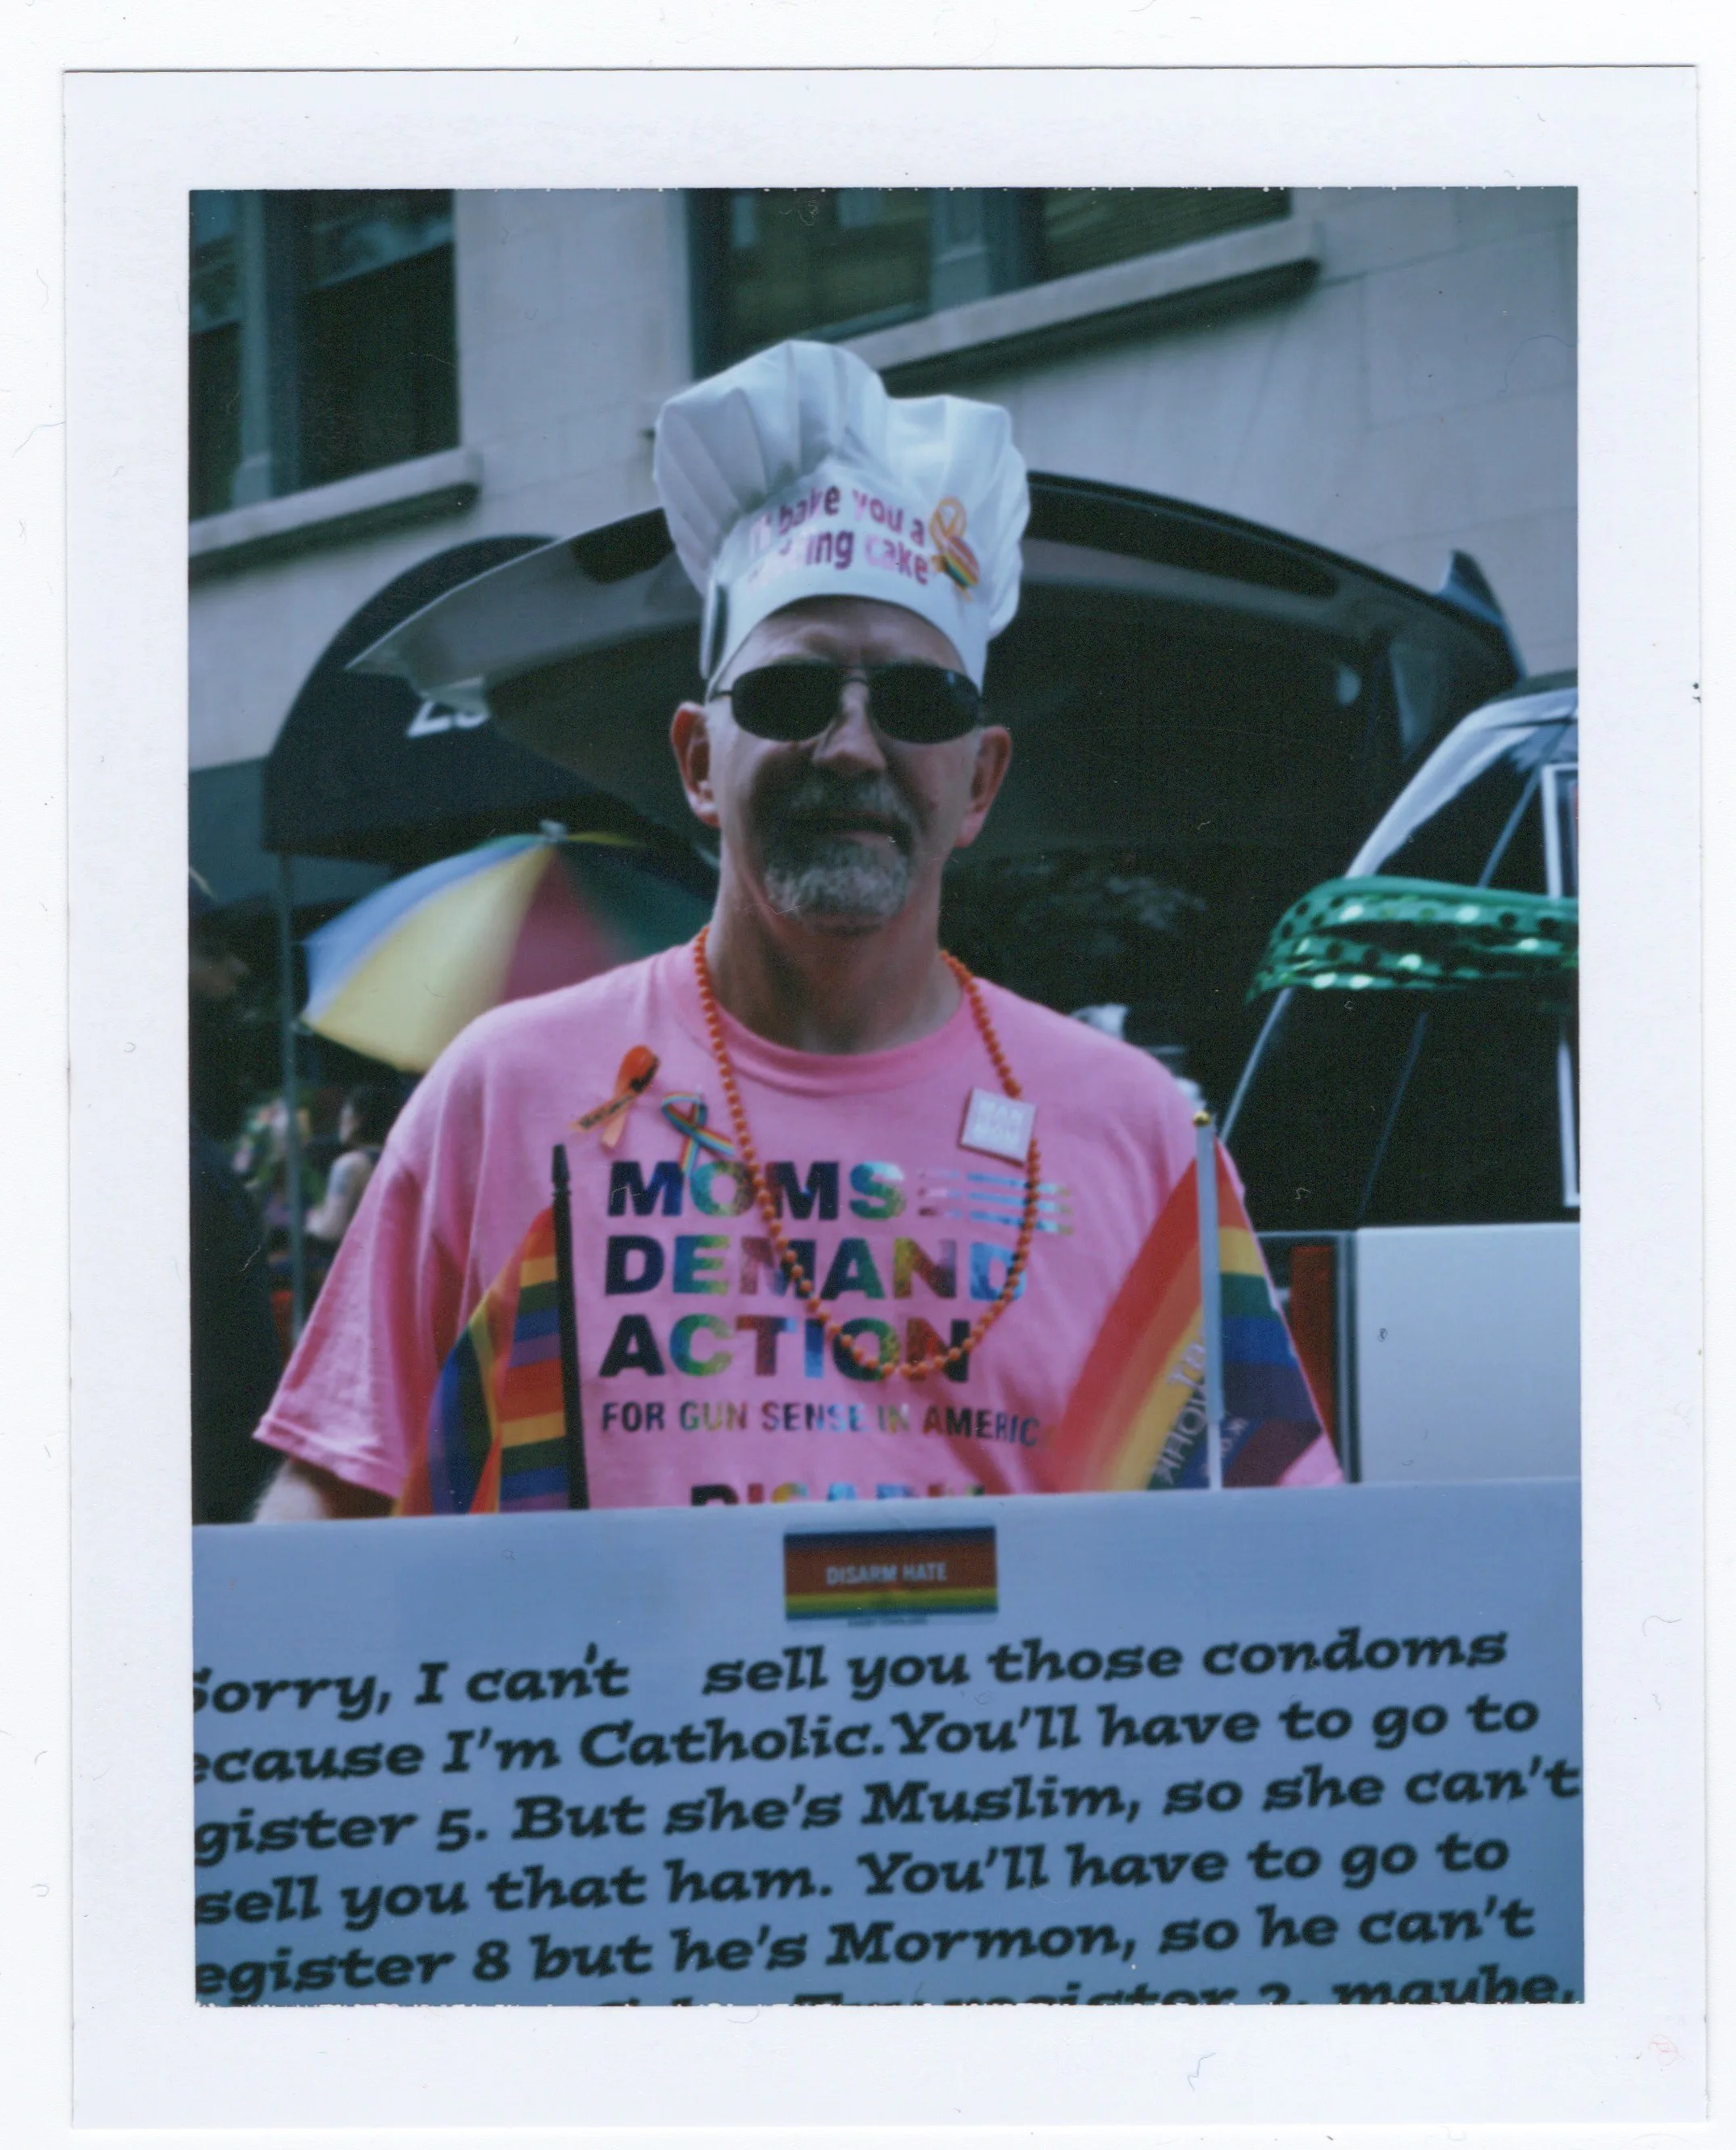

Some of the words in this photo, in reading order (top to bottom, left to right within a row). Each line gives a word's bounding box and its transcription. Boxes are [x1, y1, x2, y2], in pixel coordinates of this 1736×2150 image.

[852, 488, 904, 534] you
[909, 518, 926, 547] a
[865, 533, 929, 586] cake
[606, 1160, 907, 1221] MOMS
[605, 1234, 1028, 1302] DEMAND
[598, 1313, 971, 1383] ACTION
[601, 1402, 665, 1433] FOR
[679, 1401, 748, 1431] GUN
[761, 1402, 865, 1433] SENSE
[878, 1402, 910, 1432] IN
[825, 1564, 898, 1586] DISARM
[902, 1561, 948, 1583] HATE
[414, 1661, 449, 1706] I
[465, 1641, 630, 1704] can't
[701, 1644, 829, 1696] sell
[845, 1653, 971, 1702] you
[987, 1637, 1184, 1683] those
[1201, 1626, 1507, 1676] condoms
[442, 1726, 561, 1774] I'm
[1097, 1703, 1260, 1748] have
[1277, 1701, 1353, 1741] to
[1371, 1704, 1449, 1750] go
[1466, 1694, 1540, 1733] to
[436, 1808, 488, 1853] 5.
[510, 1795, 647, 1841] But
[663, 1783, 843, 1836] she's
[860, 1775, 1141, 1825] Muslim,
[1162, 1779, 1243, 1817] so
[1261, 1762, 1386, 1813] she
[1404, 1754, 1580, 1805] can't
[194, 1874, 322, 1929] sell
[339, 1881, 469, 1933] you
[485, 1863, 648, 1912] that
[663, 1858, 832, 1904] ham.
[856, 1844, 1050, 1896] You'll
[1064, 1842, 1229, 1888] have
[1247, 1840, 1322, 1881] to
[1340, 1842, 1419, 1890] go
[1435, 1832, 1510, 1873] to
[472, 1938, 511, 1983] 8
[529, 1933, 653, 1981] but
[669, 1924, 808, 1973] he's
[824, 1921, 1137, 1967] Mormon,
[1157, 1917, 1240, 1955] so
[1255, 1903, 1340, 1948] he
[1357, 1894, 1536, 1946] can't
